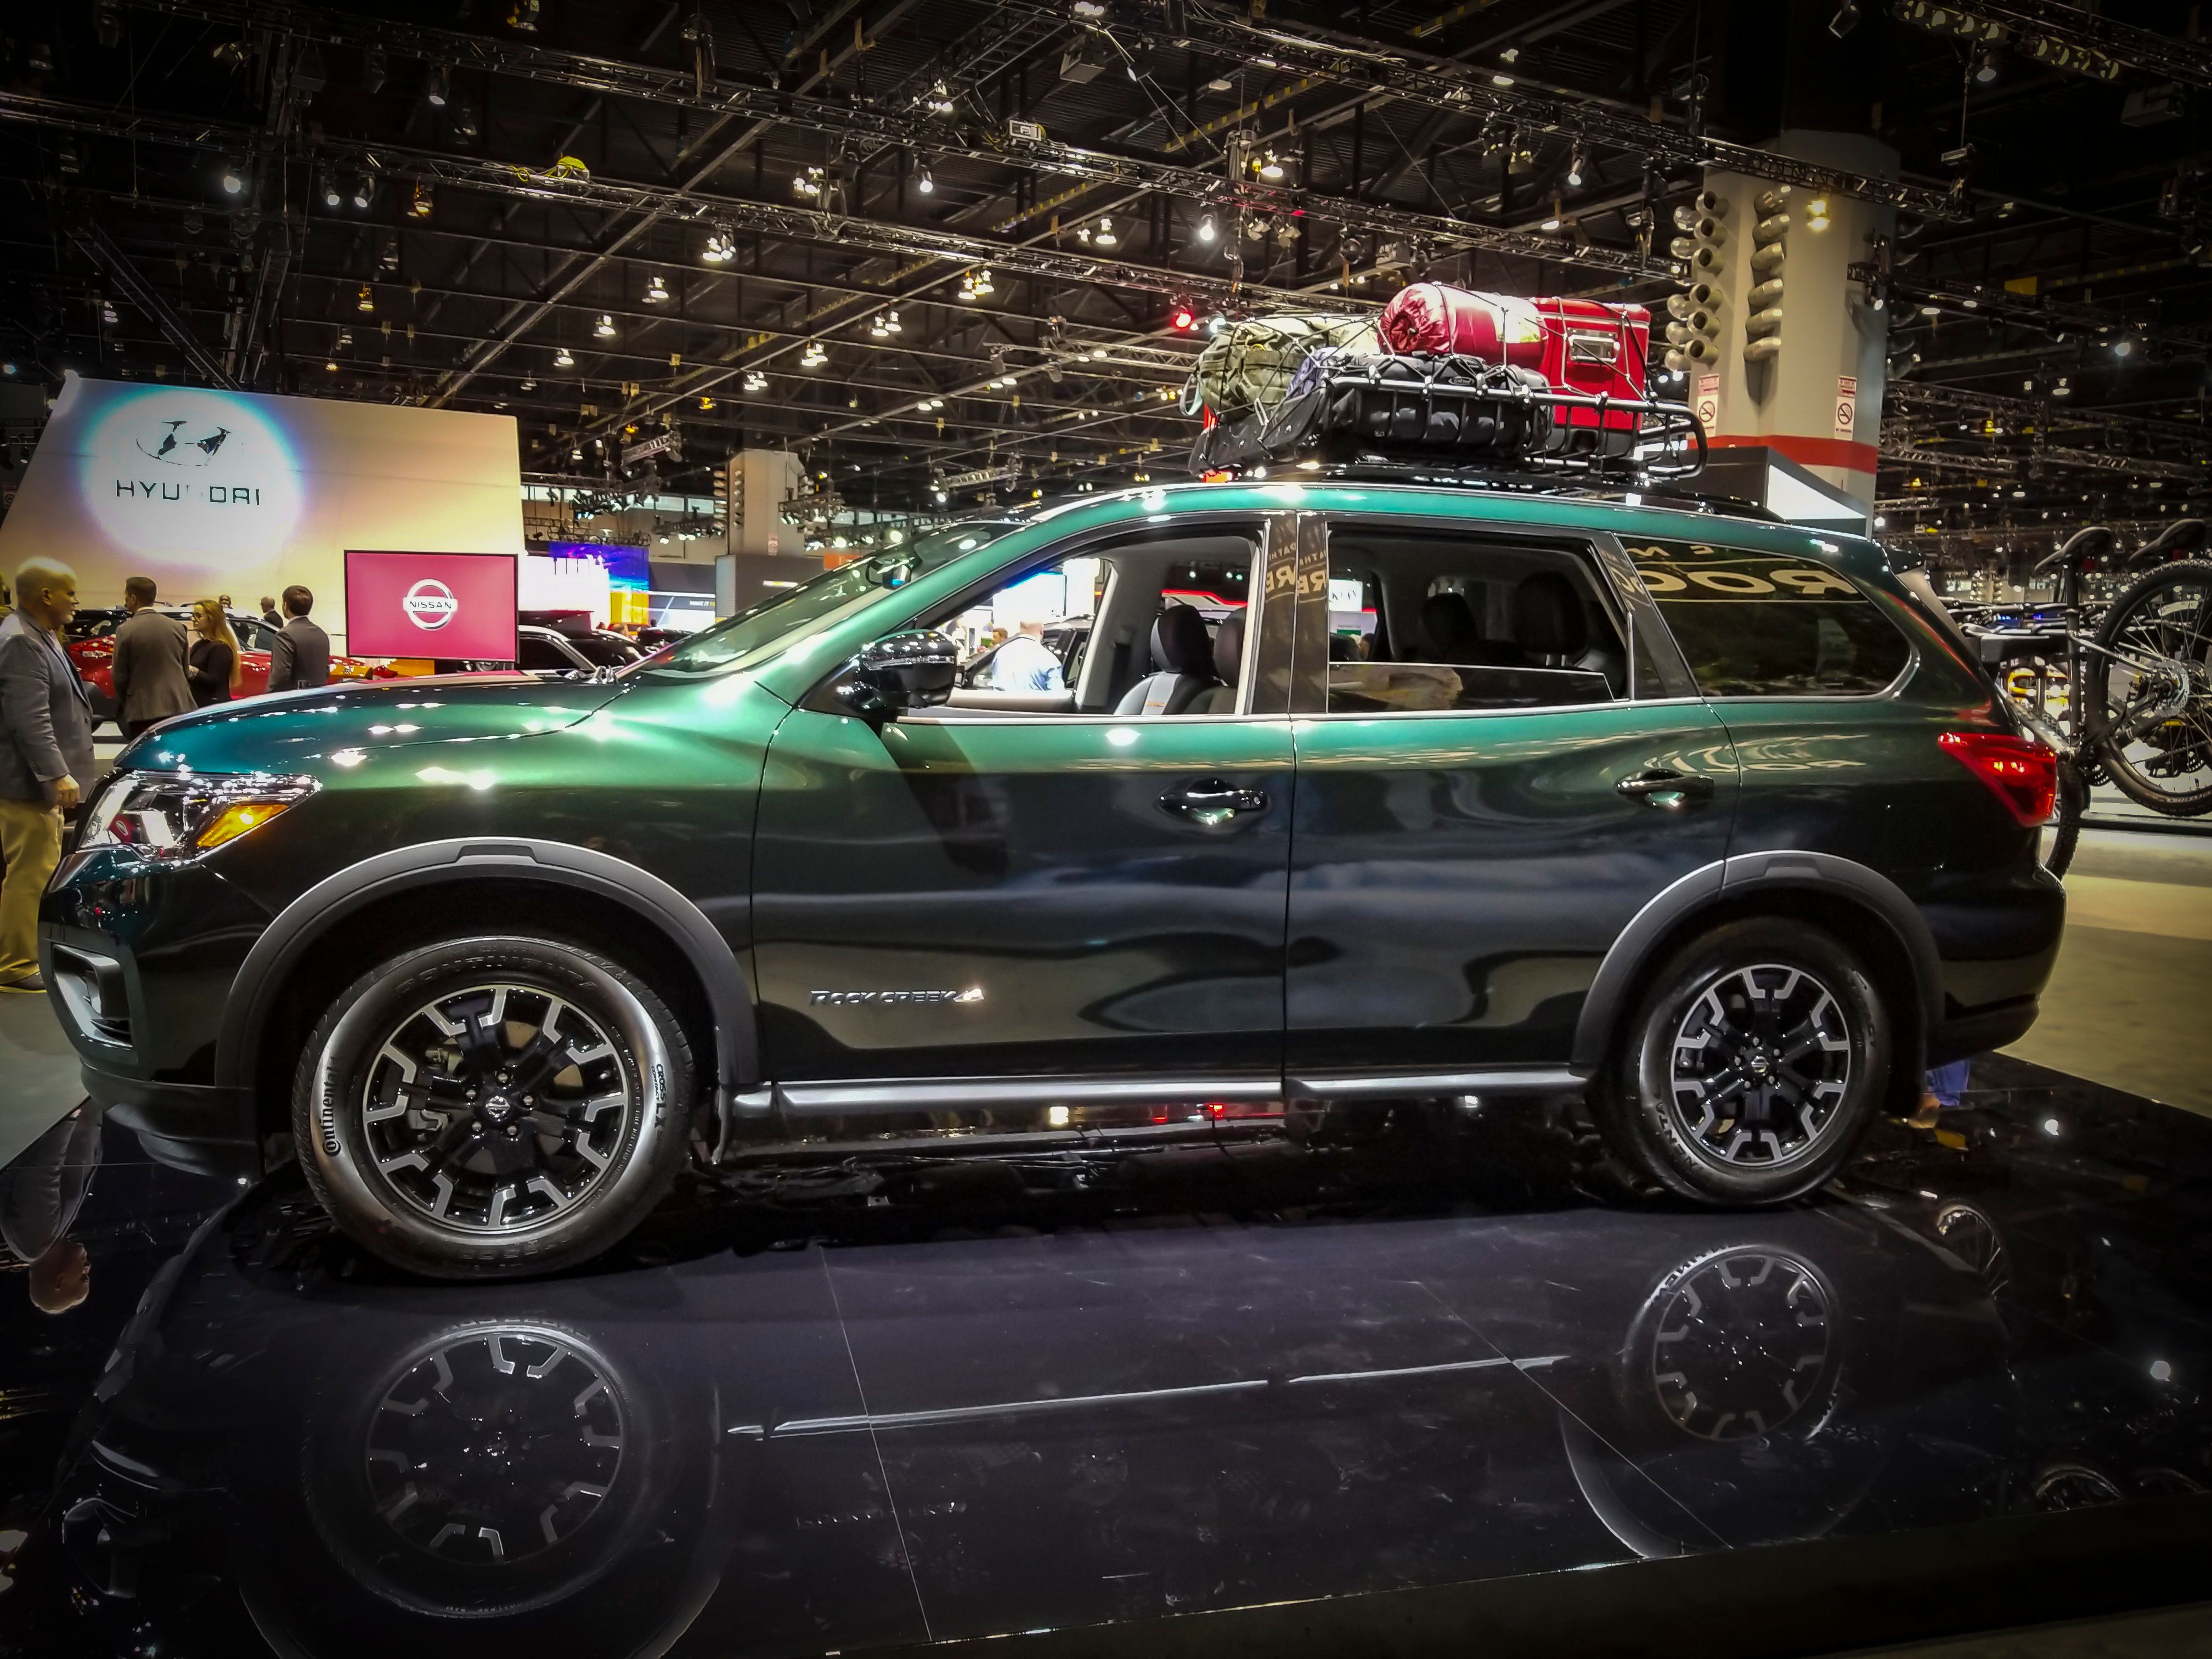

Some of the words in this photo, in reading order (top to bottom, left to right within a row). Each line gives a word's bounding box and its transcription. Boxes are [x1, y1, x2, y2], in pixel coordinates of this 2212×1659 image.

[116, 479, 259, 506] HYUDAI
[409, 601, 452, 609] NISSAN
[810, 990, 877, 1005] ROCK
[880, 990, 957, 1004] CREEK
[656, 1064, 667, 1101] CROSS
[319, 1066, 341, 1157] Continental
